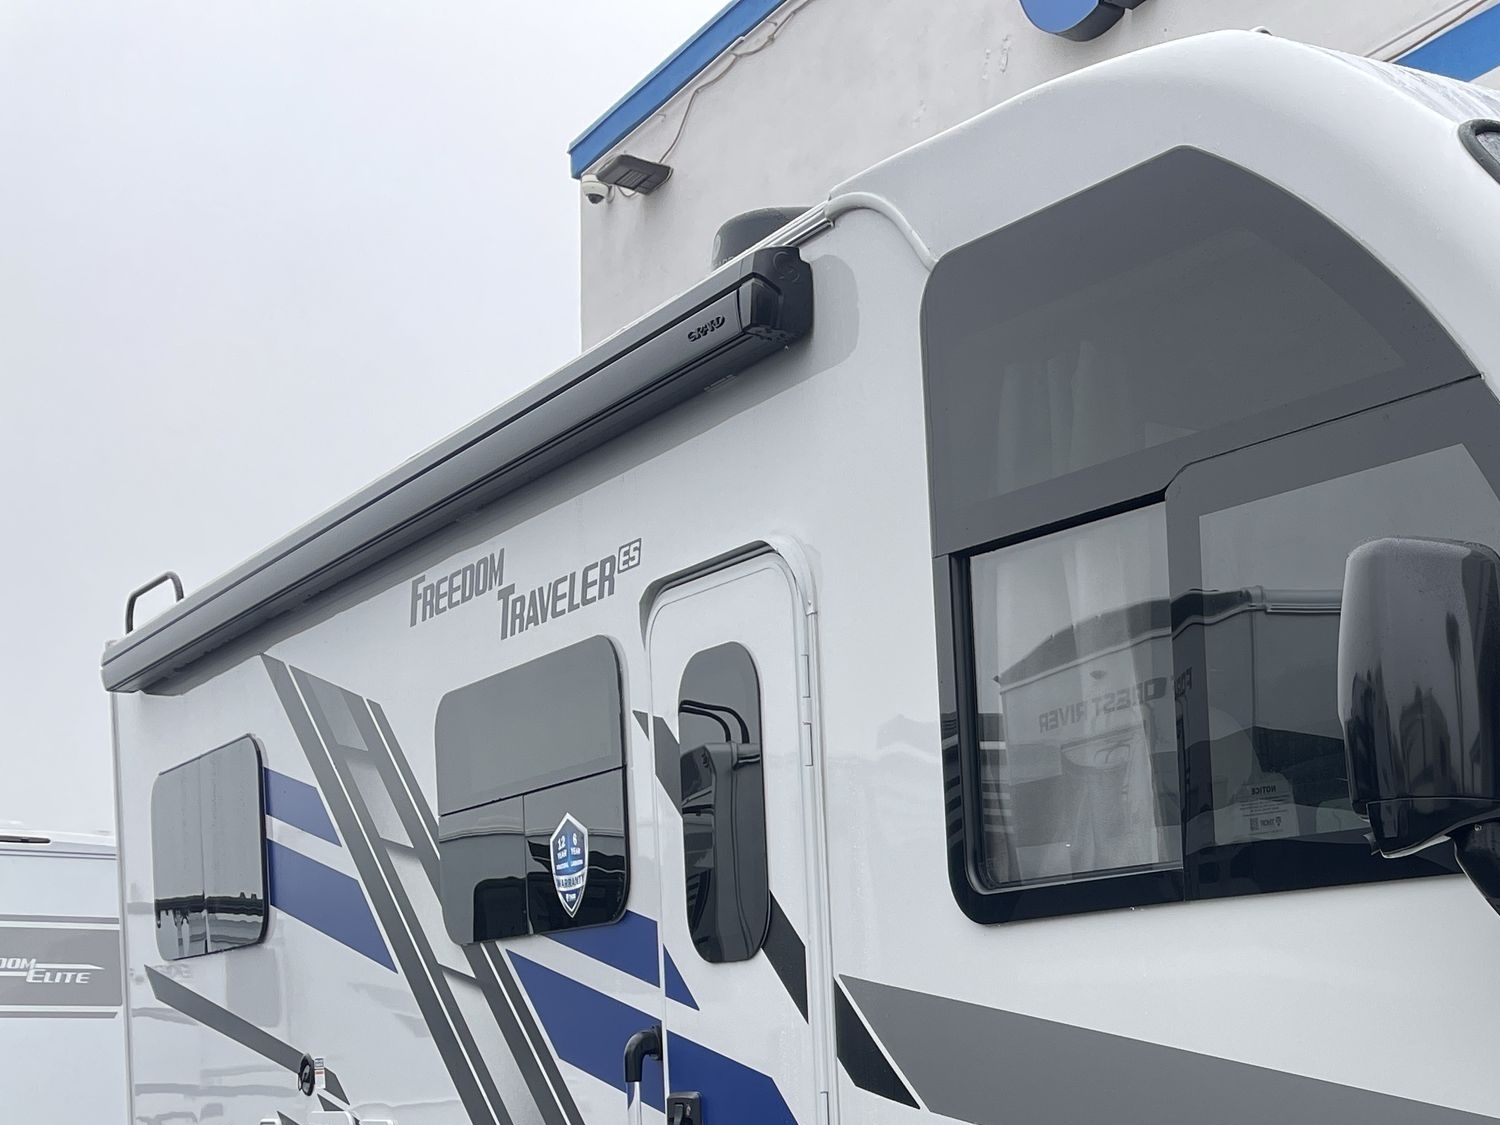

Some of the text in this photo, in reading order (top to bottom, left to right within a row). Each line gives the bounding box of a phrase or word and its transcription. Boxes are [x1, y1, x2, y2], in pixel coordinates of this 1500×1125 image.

[619, 541, 640, 571] ES
[410, 547, 505, 628] FREEDOM
[497, 554, 617, 641] TRAVELER
[557, 835, 566, 850] 12
[26, 969, 92, 984] ELITE
